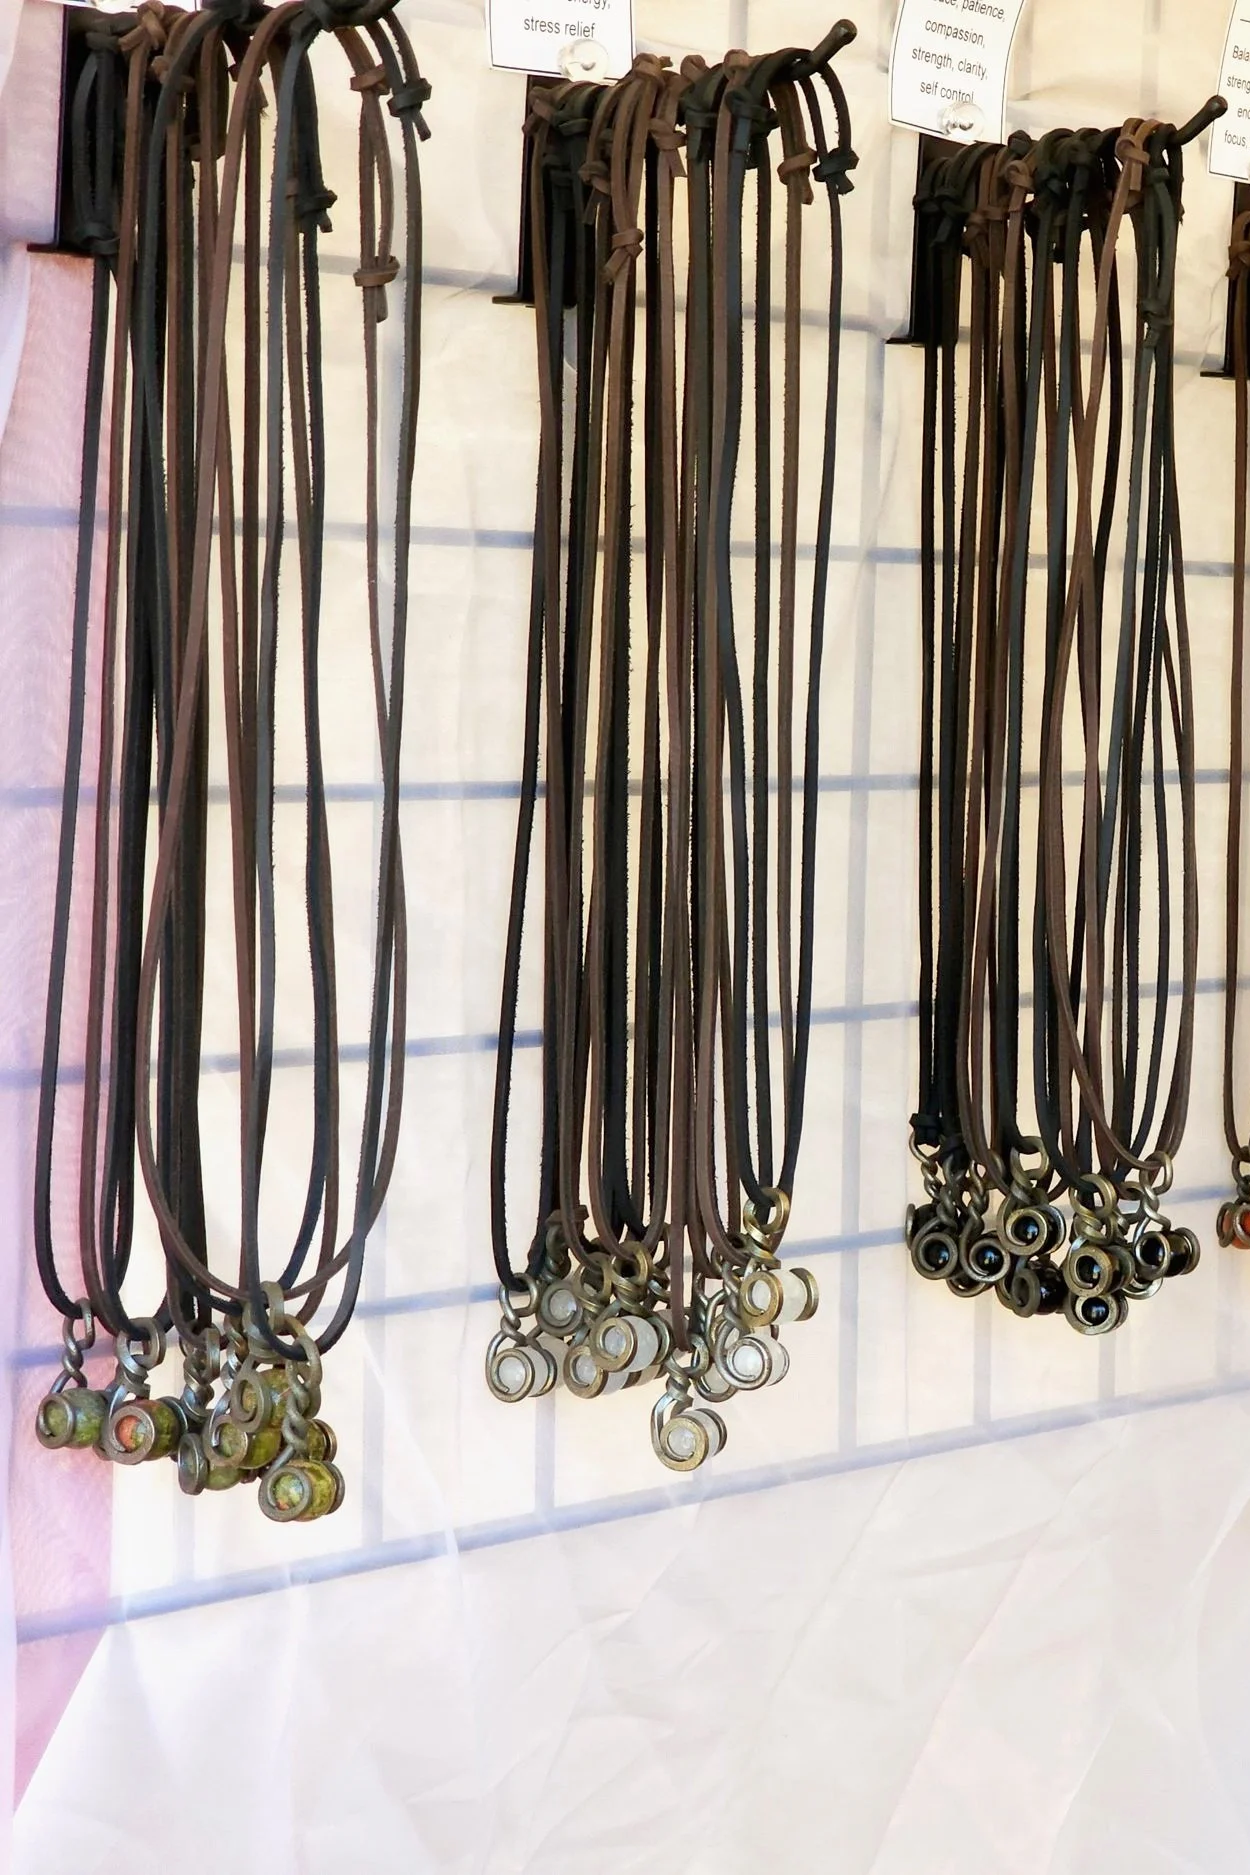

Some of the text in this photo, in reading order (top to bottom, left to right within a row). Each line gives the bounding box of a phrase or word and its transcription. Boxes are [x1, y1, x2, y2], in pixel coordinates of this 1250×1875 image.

[523, 16, 595, 38] stress relief
[925, 20, 985, 48] compassion,
[912, 47, 988, 80] strength, clarity,
[920, 81, 939, 96] self
[1224, 130, 1248, 149] focus,
